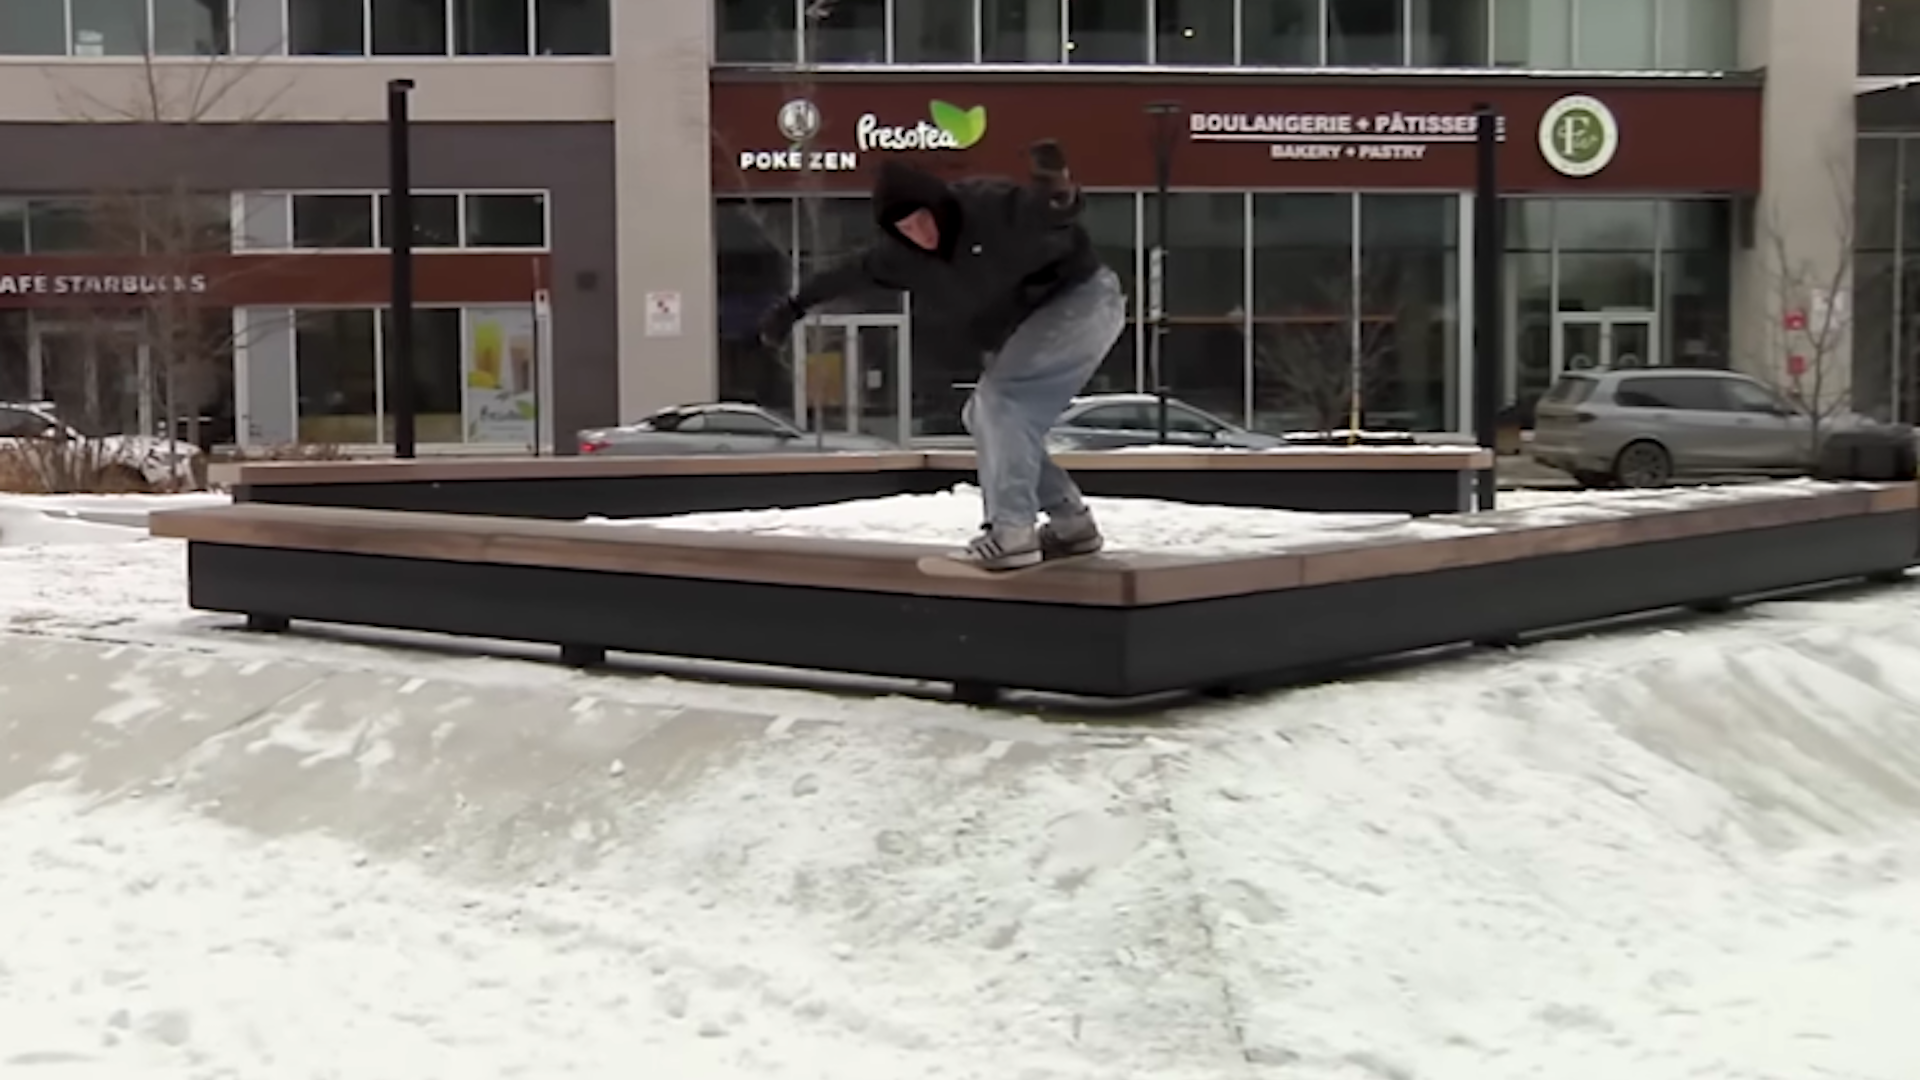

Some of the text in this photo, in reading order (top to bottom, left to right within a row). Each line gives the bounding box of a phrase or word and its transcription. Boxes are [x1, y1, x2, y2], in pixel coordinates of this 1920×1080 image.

[857, 113, 959, 152] Presotea
[1190, 113, 1352, 134] BOULANGERIE
[1374, 111, 1506, 134] PÂTISSERE
[808, 152, 857, 171] ZEN
[1269, 144, 1342, 159] BAKERY
[1358, 144, 1427, 159] PASTRY
